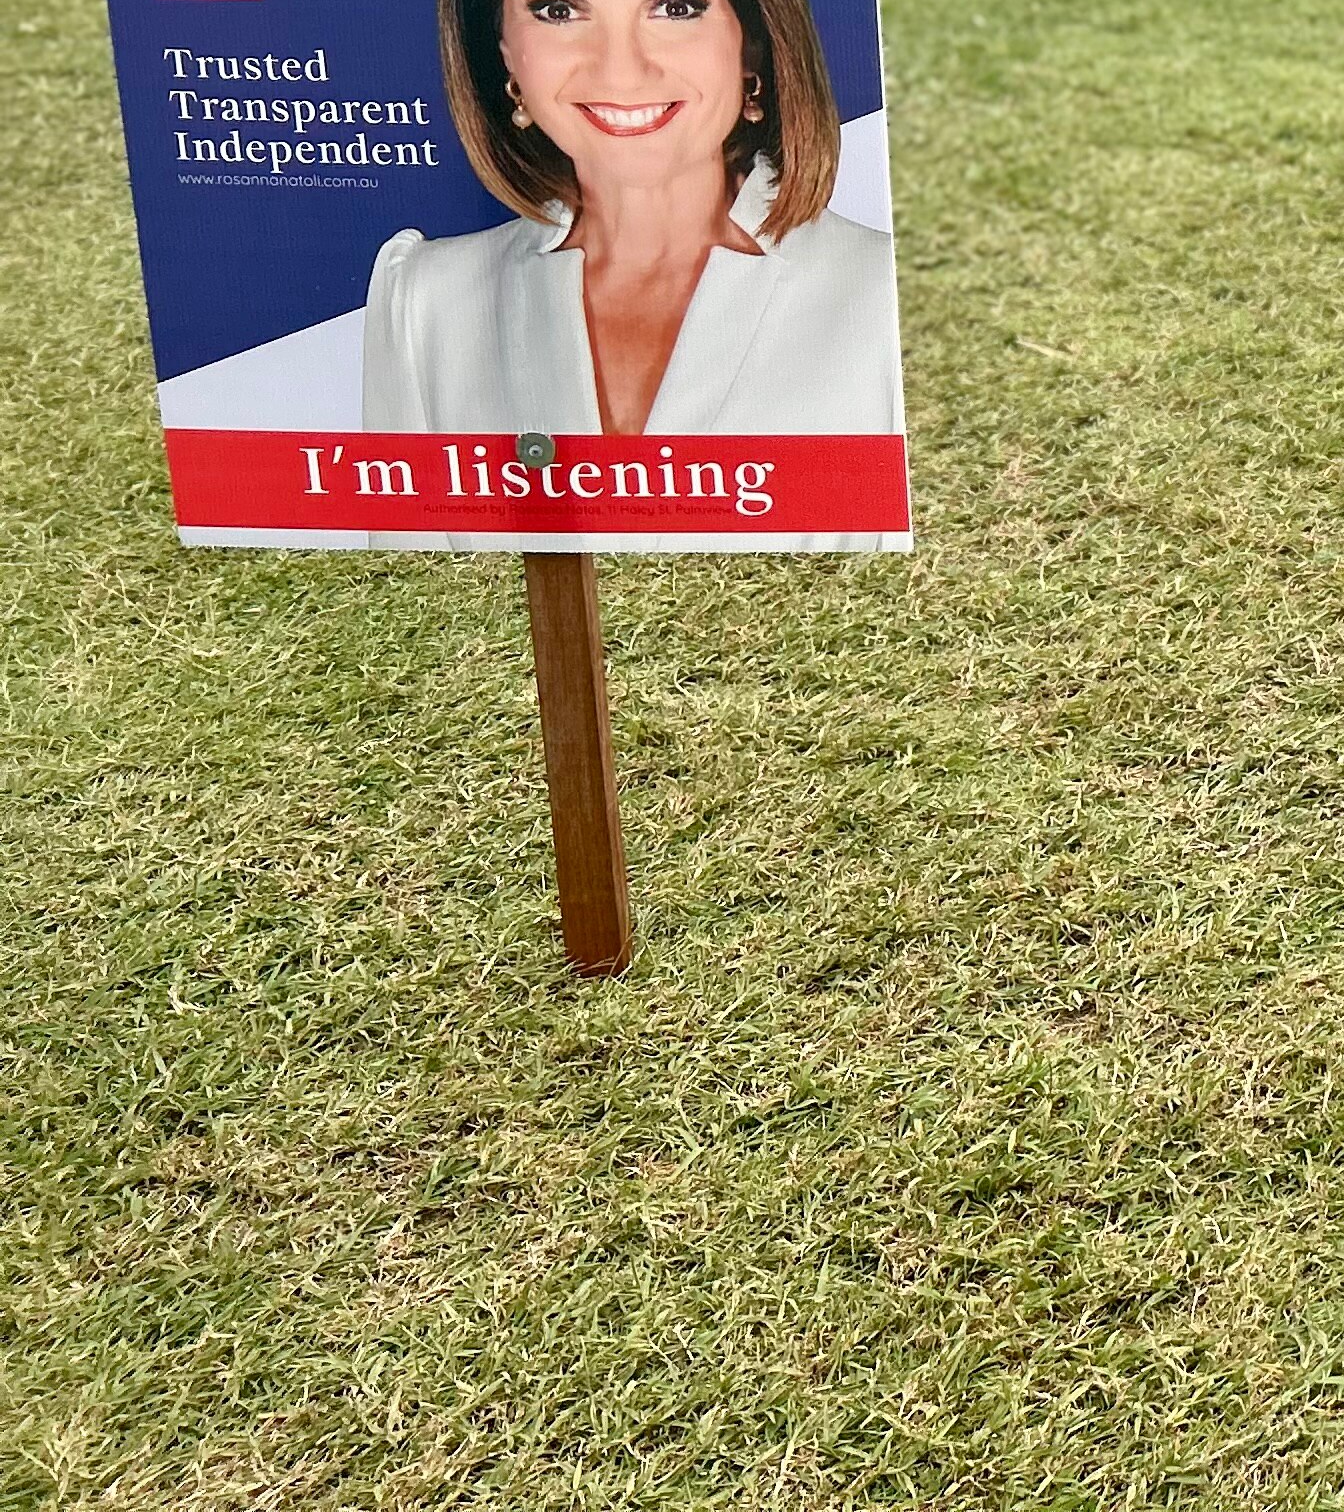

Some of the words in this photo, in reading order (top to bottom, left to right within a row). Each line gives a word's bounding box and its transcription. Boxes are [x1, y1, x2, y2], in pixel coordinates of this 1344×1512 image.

[163, 48, 329, 82] Trusted
[168, 90, 430, 133] Transparent
[173, 130, 440, 174] Independent
[177, 173, 379, 189] www.rosannanatoli.com.au
[299, 444, 420, 496] I'm
[442, 444, 776, 516] listening
